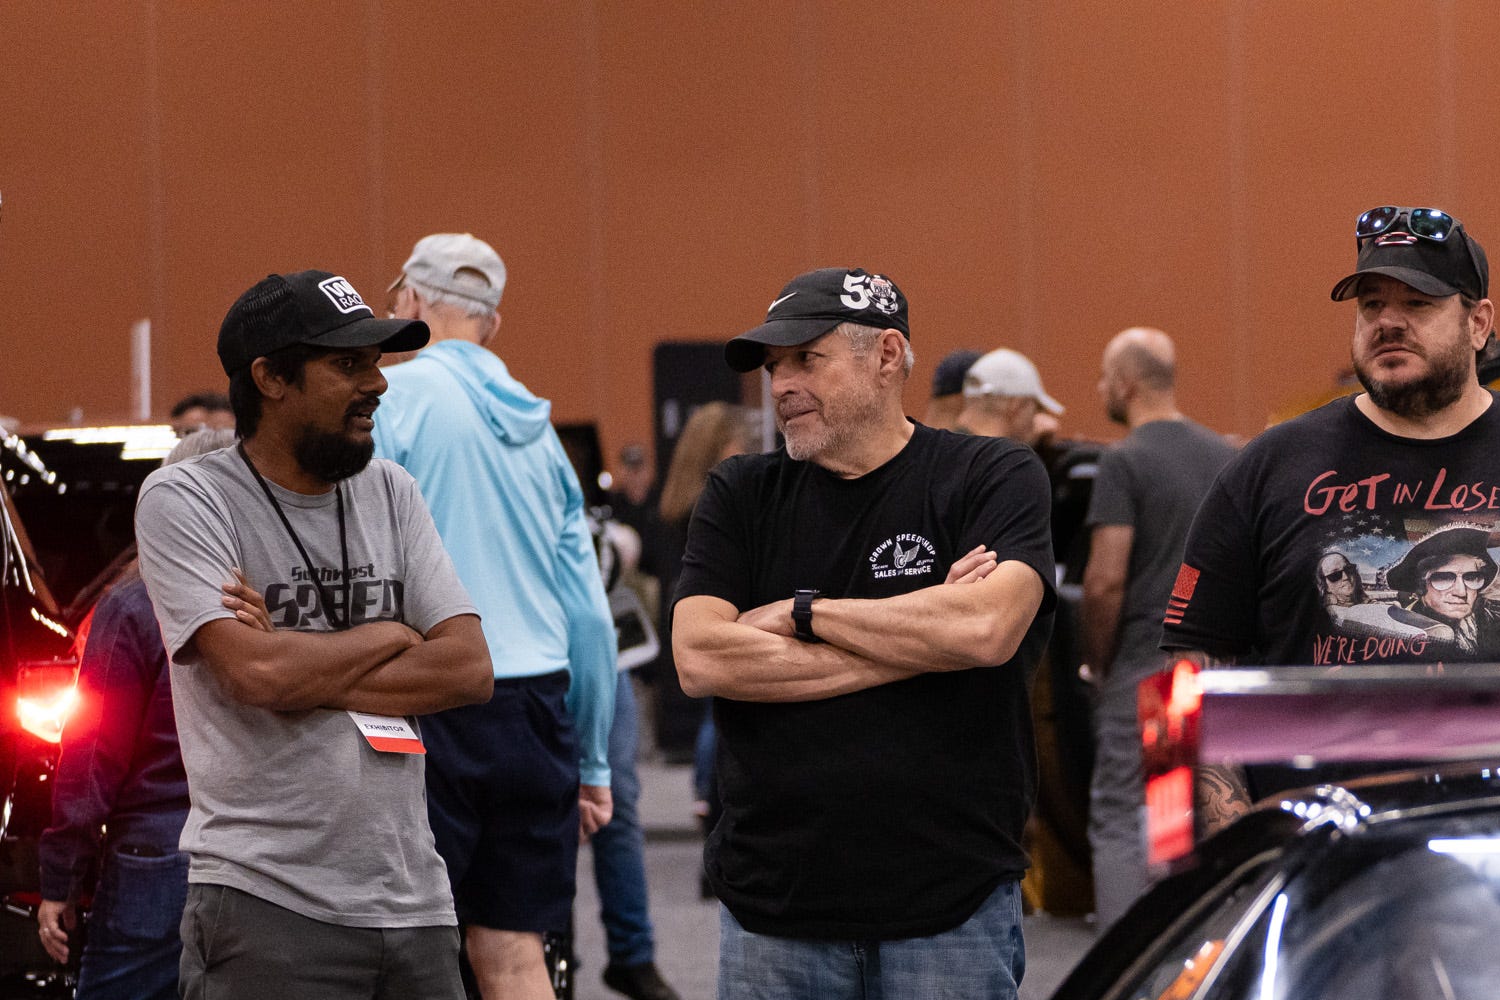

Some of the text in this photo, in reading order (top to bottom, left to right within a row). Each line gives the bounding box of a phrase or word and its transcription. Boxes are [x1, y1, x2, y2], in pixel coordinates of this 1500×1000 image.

[869, 538, 893, 562] CROWN
[874, 569, 897, 578] SALES
[904, 565, 931, 575] SERVICE
[1357, 633, 1431, 661] DOING
[364, 723, 405, 733] EXHIBITOR
